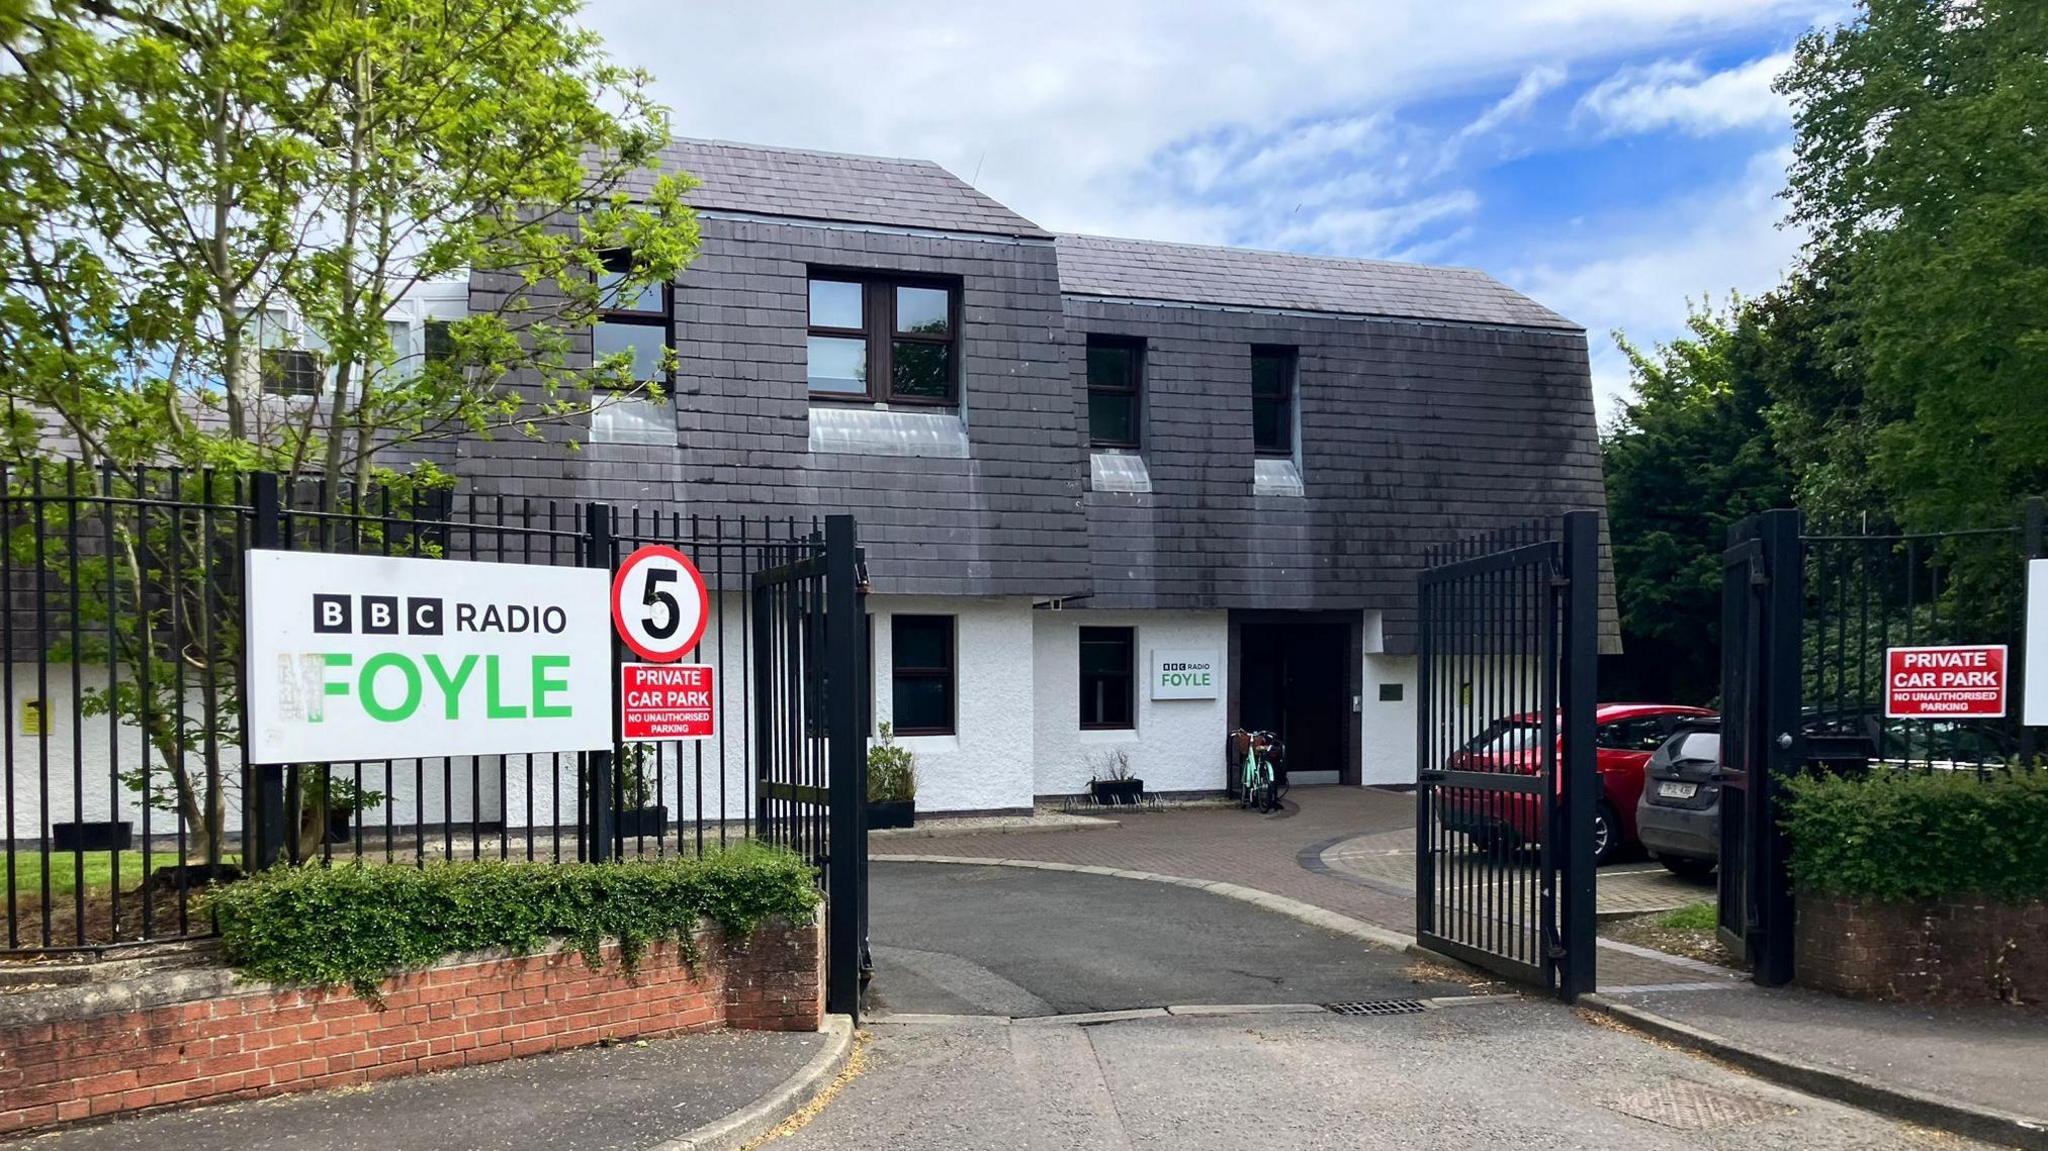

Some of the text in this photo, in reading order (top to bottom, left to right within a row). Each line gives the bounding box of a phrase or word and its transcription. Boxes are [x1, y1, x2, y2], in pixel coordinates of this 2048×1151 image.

[641, 568, 681, 640] 5
[313, 593, 567, 636] BBC RADIO
[1904, 652, 1987, 668] PRIVATE
[636, 670, 701, 686] PRIVATE
[1162, 673, 1211, 687] FOYLE
[1894, 671, 1997, 687] CAR PARK
[308, 652, 573, 723] FOYLE
[628, 691, 709, 706] CAR PARK
[1894, 691, 1997, 701] NO UNAUTHORISED
[1920, 702, 1969, 711] PARKING
[628, 713, 710, 723] NO UNAUTHORISED
[651, 724, 689, 734] PARKING
